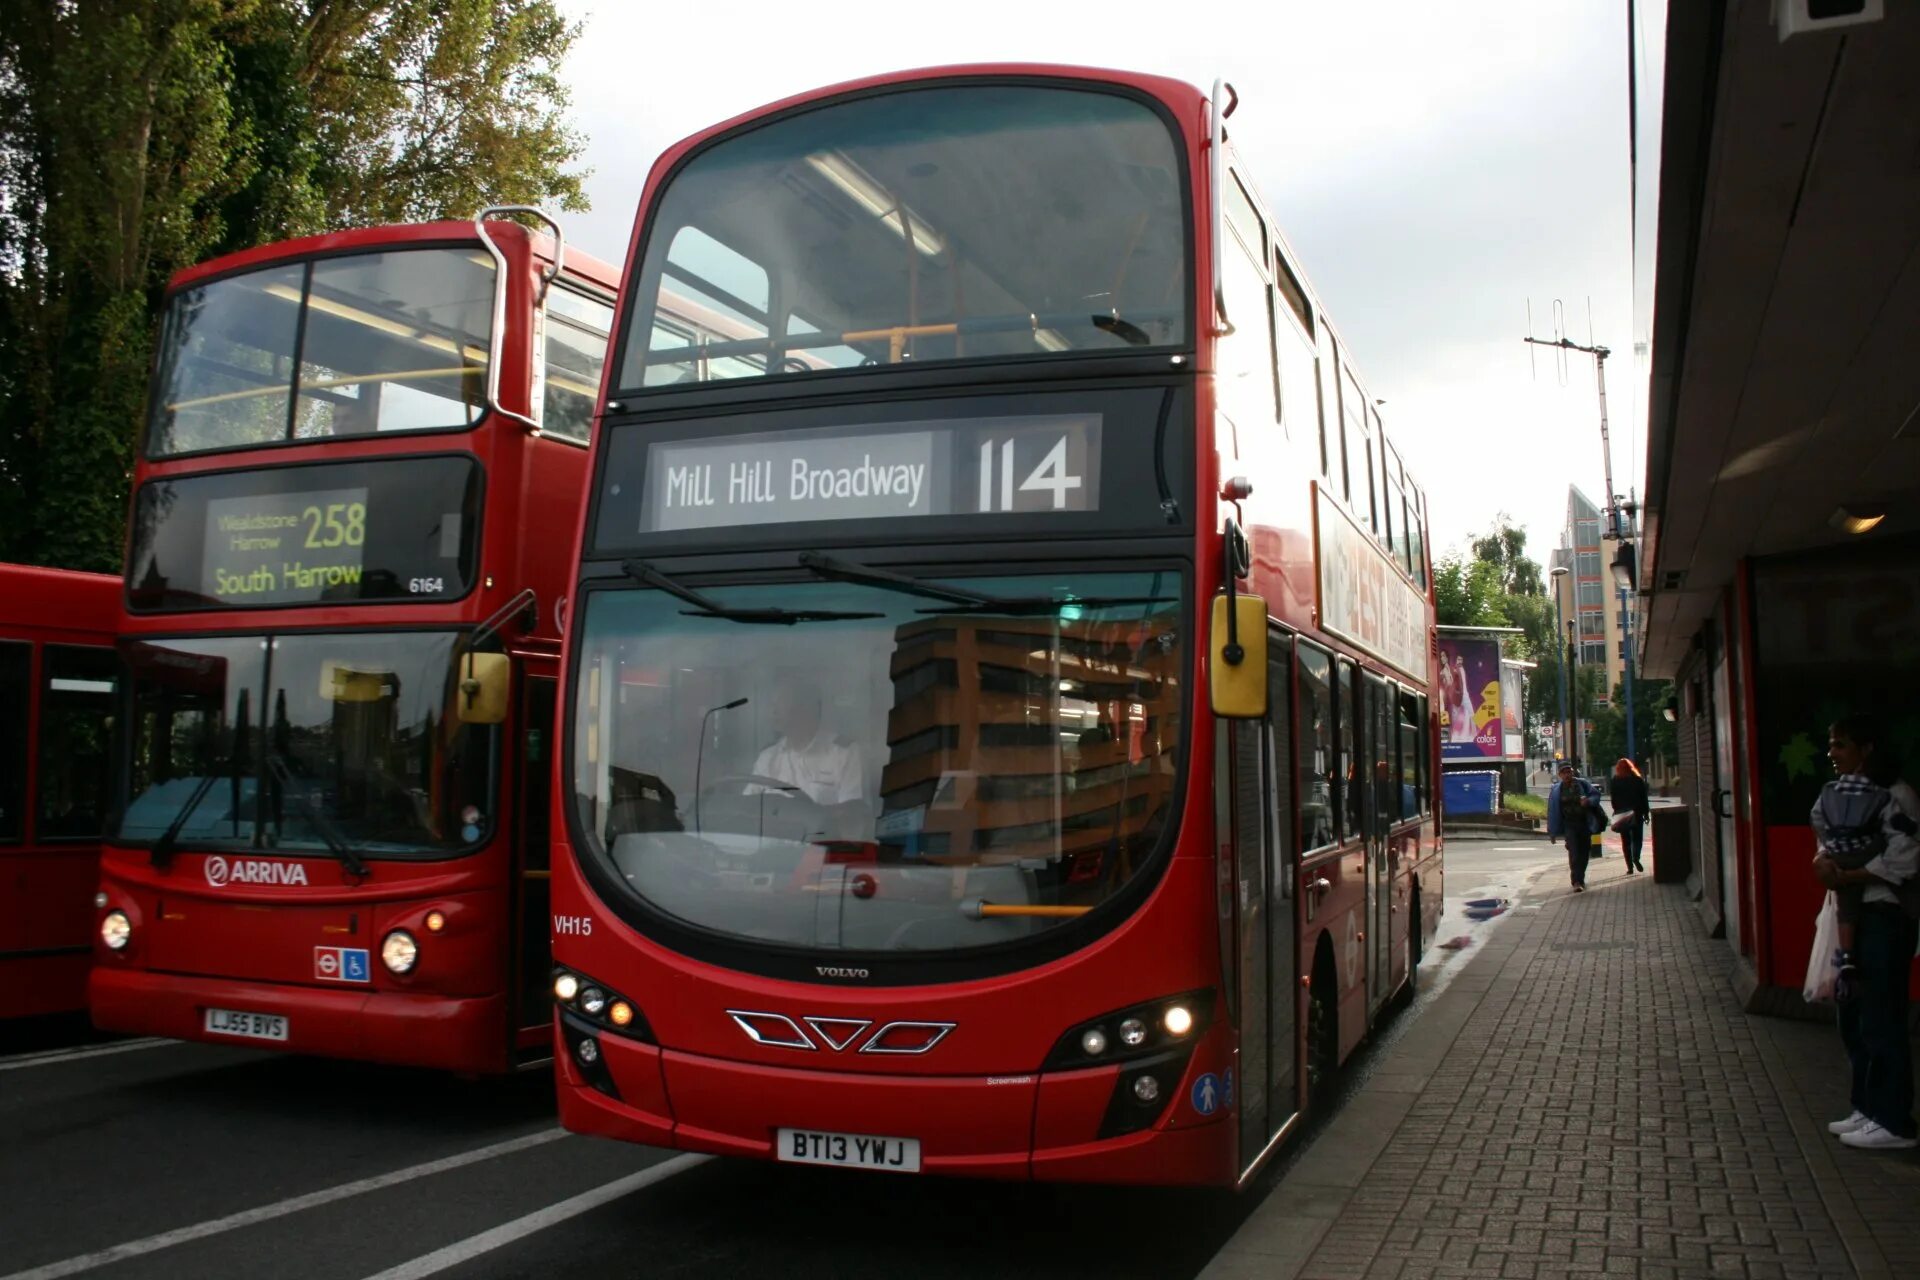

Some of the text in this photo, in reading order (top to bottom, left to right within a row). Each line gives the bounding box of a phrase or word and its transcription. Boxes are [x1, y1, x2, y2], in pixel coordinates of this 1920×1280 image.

[666, 454, 925, 508] Mill Hill Broadway
[979, 435, 1081, 512] 114
[217, 512, 298, 531] Wealdstone
[303, 503, 366, 549] 258
[230, 533, 281, 551] Harrow
[215, 562, 362, 595] South Harrow
[409, 577, 443, 593] 6164
[1476, 734, 1497, 744] colors
[230, 861, 309, 886] ARRIVA
[554, 914, 592, 936] VH15
[815, 966, 869, 978] VOLVO
[210, 1009, 283, 1037] LJ55 BVS
[793, 1132, 904, 1166] BT13 YWJ
